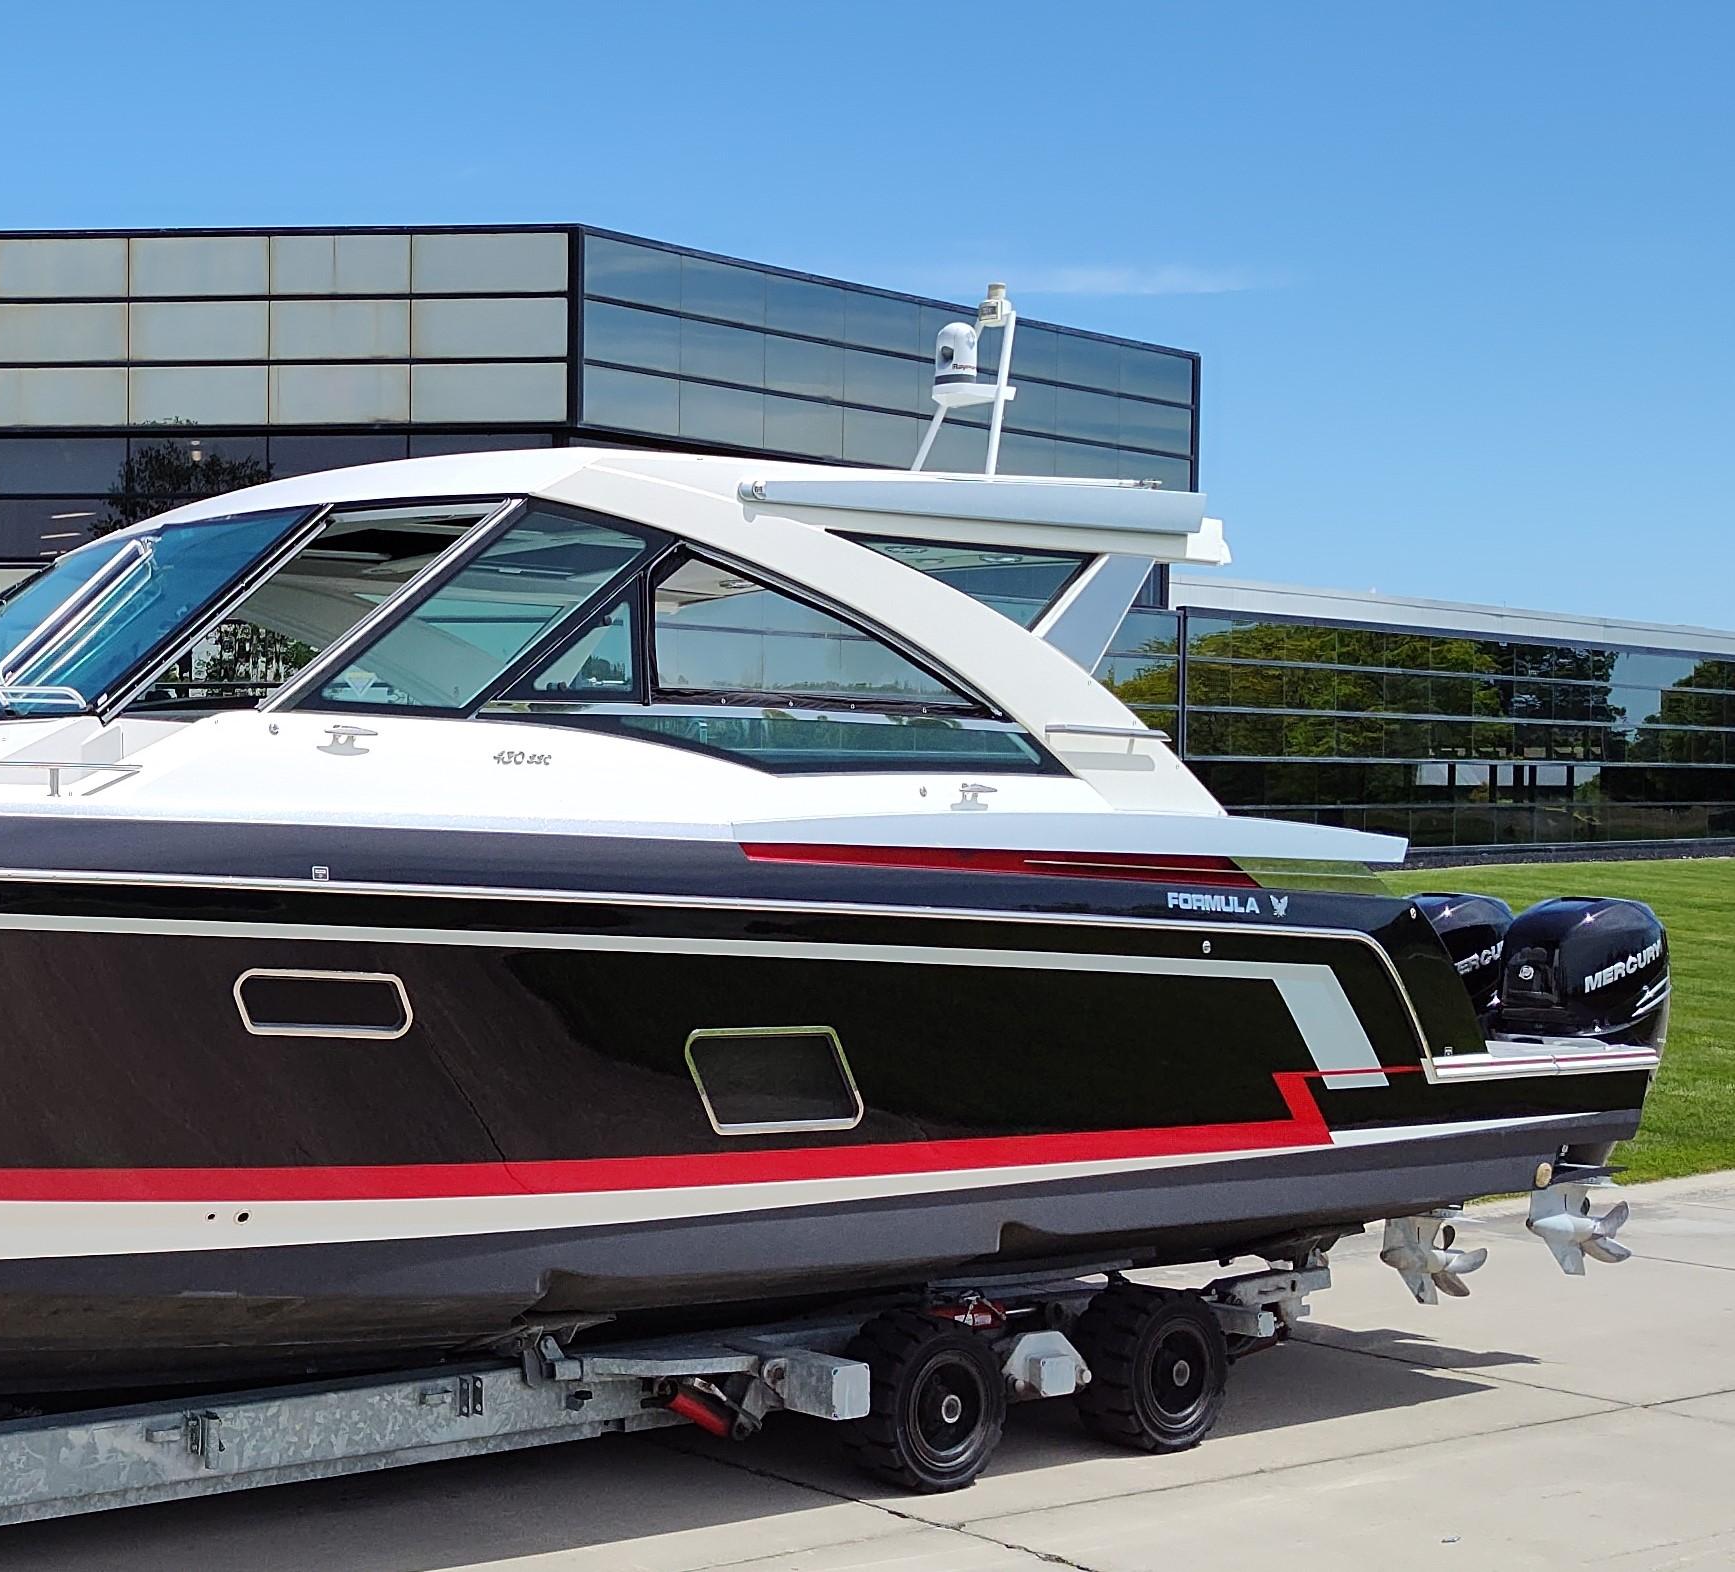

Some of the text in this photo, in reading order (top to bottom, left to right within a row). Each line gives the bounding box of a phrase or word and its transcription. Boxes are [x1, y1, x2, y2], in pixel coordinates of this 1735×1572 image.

[1167, 892, 1261, 914] FORMULA
[1453, 940, 1504, 975] ERCU
[1585, 939, 1663, 993] MERCURY
